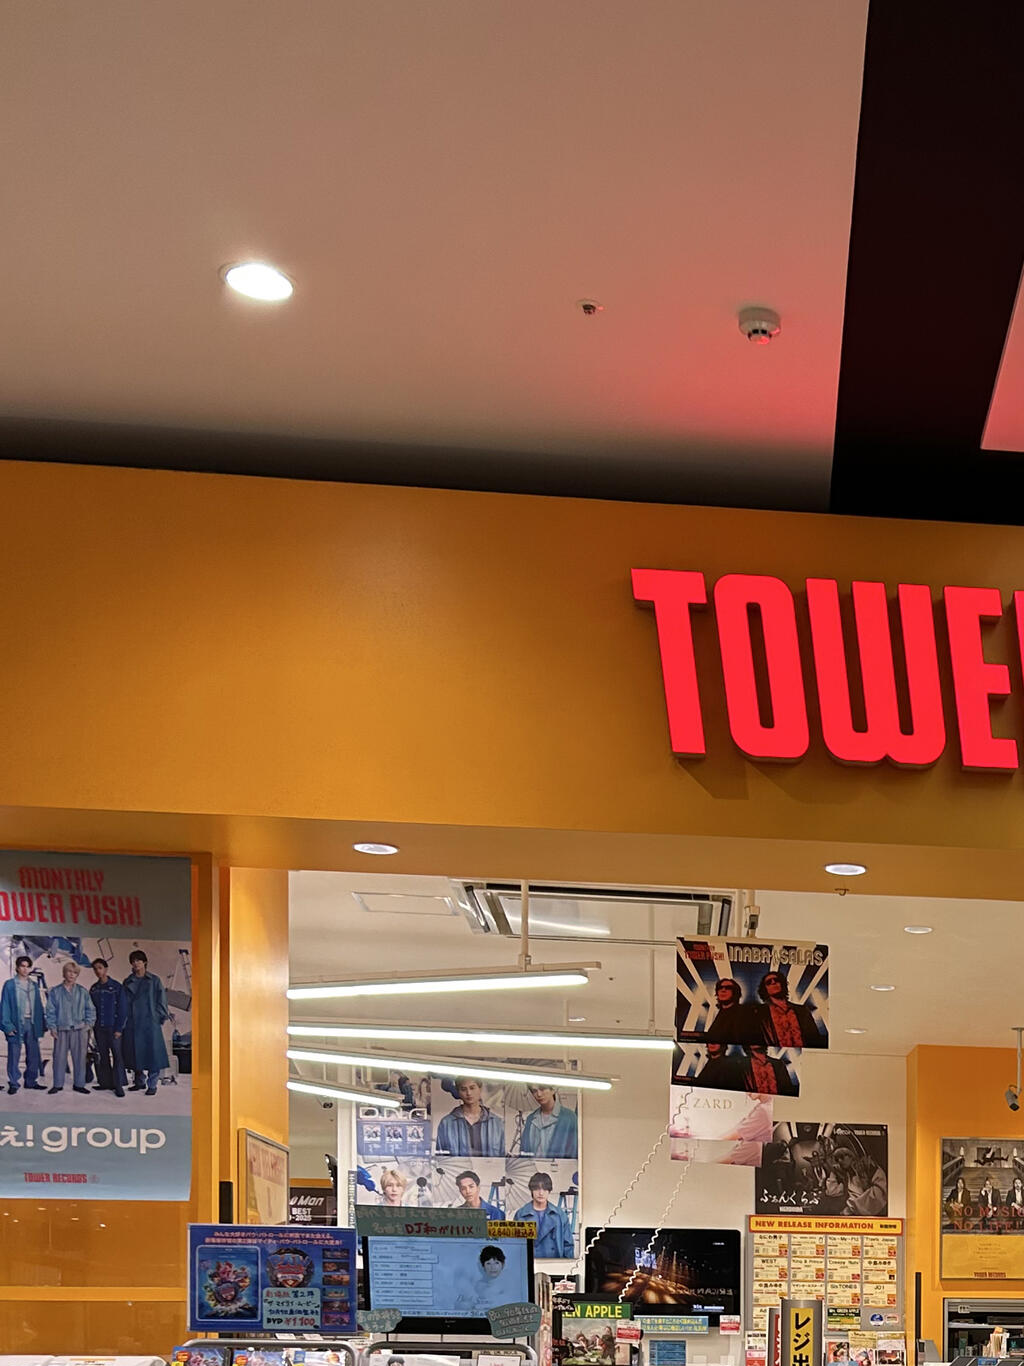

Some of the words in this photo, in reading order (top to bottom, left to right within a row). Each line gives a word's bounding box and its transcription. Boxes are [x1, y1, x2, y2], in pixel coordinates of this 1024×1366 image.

[18, 866, 105, 892] MONTHLY
[0, 891, 65, 925] WER
[71, 895, 143, 927] PUSH!
[693, 1098, 732, 1110] ZARD
[41, 1125, 167, 1154] group
[953, 1206, 973, 1218] NO
[755, 1220, 774, 1228] NEW
[778, 1220, 812, 1229] RELEASE
[815, 1221, 874, 1230] INFORMATION
[953, 1220, 973, 1232] NO
[979, 1220, 1020, 1232] LIFE!
[586, 1305, 622, 1318] APPLE
